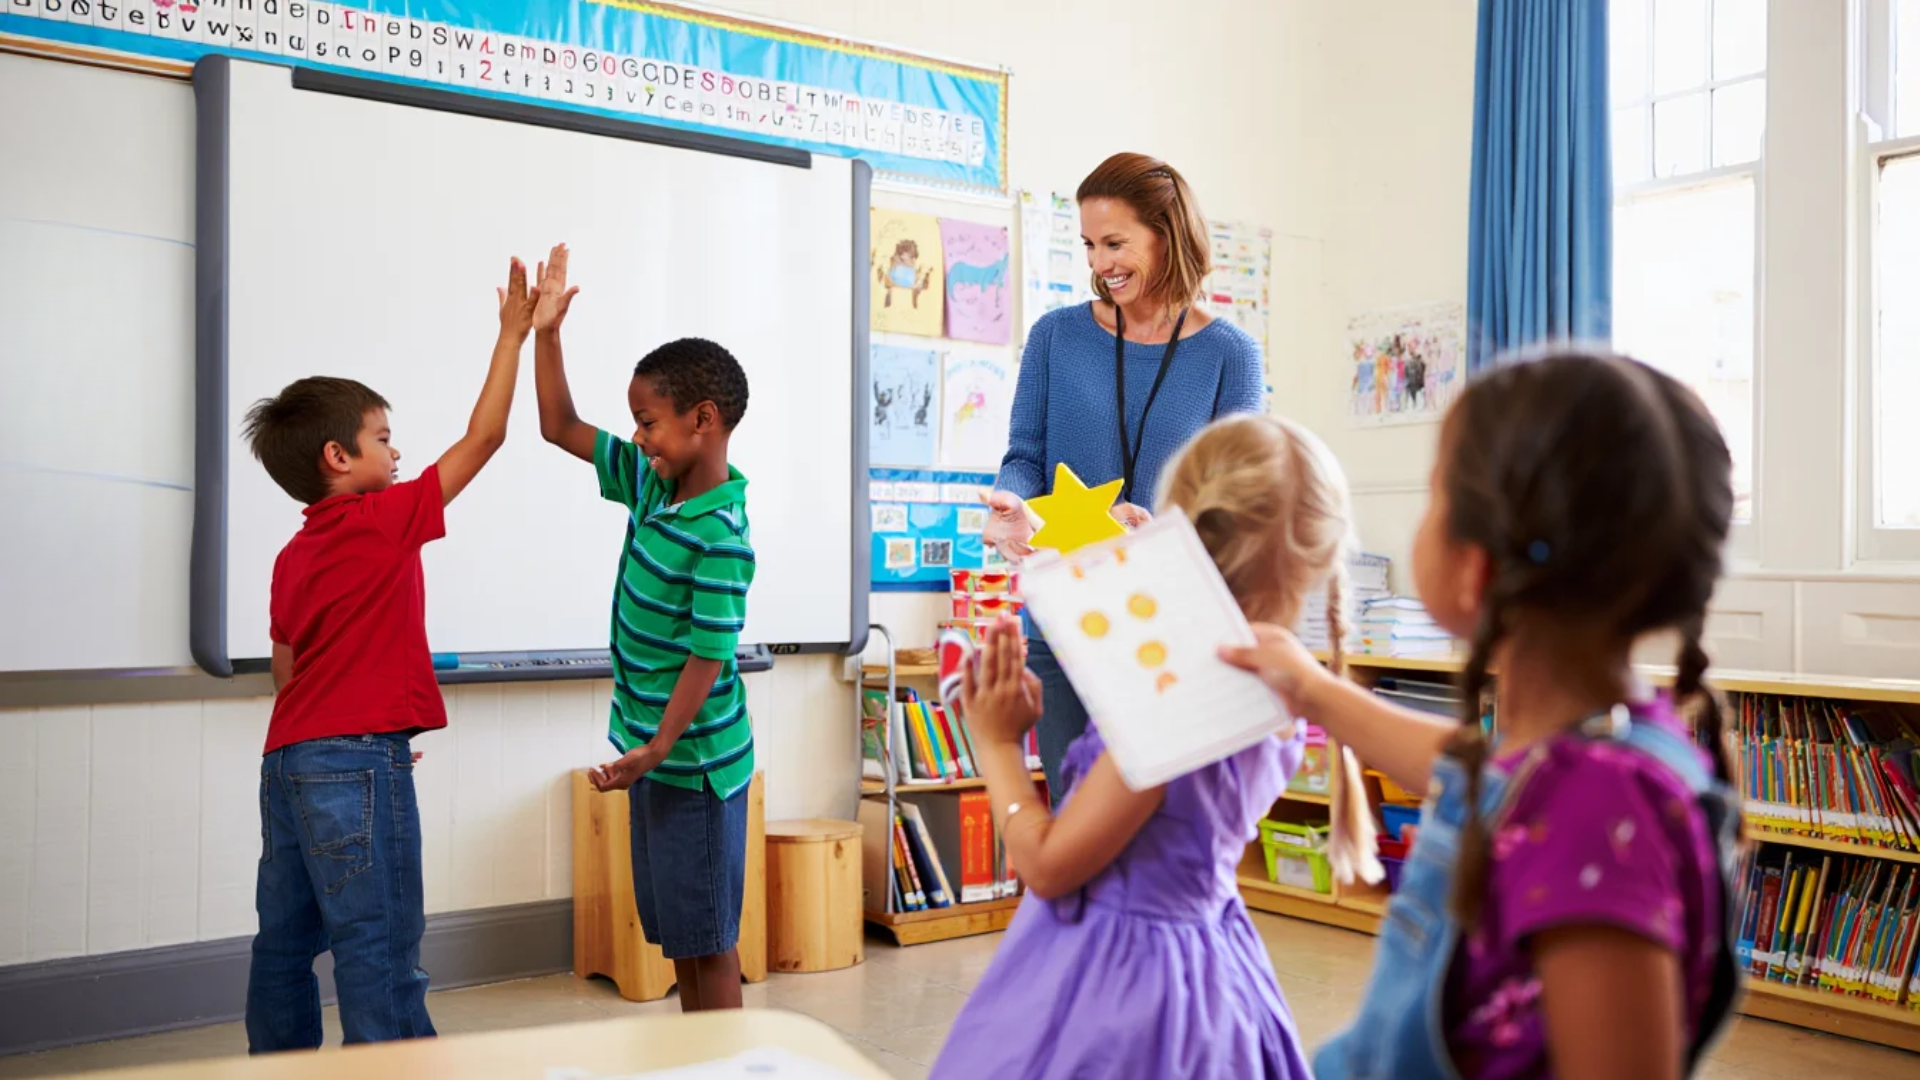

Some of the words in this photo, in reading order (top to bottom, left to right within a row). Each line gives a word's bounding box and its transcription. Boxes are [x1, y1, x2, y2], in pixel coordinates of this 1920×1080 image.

[129, 9, 145, 25] e
[182, 18, 195, 32] v
[207, 21, 230, 36] w
[389, 46, 401, 64] P
[480, 60, 493, 81] 2
[290, 3, 305, 18] e
[433, 27, 447, 45] S
[455, 31, 474, 51] W
[664, 65, 679, 86] D
[700, 71, 715, 92] S
